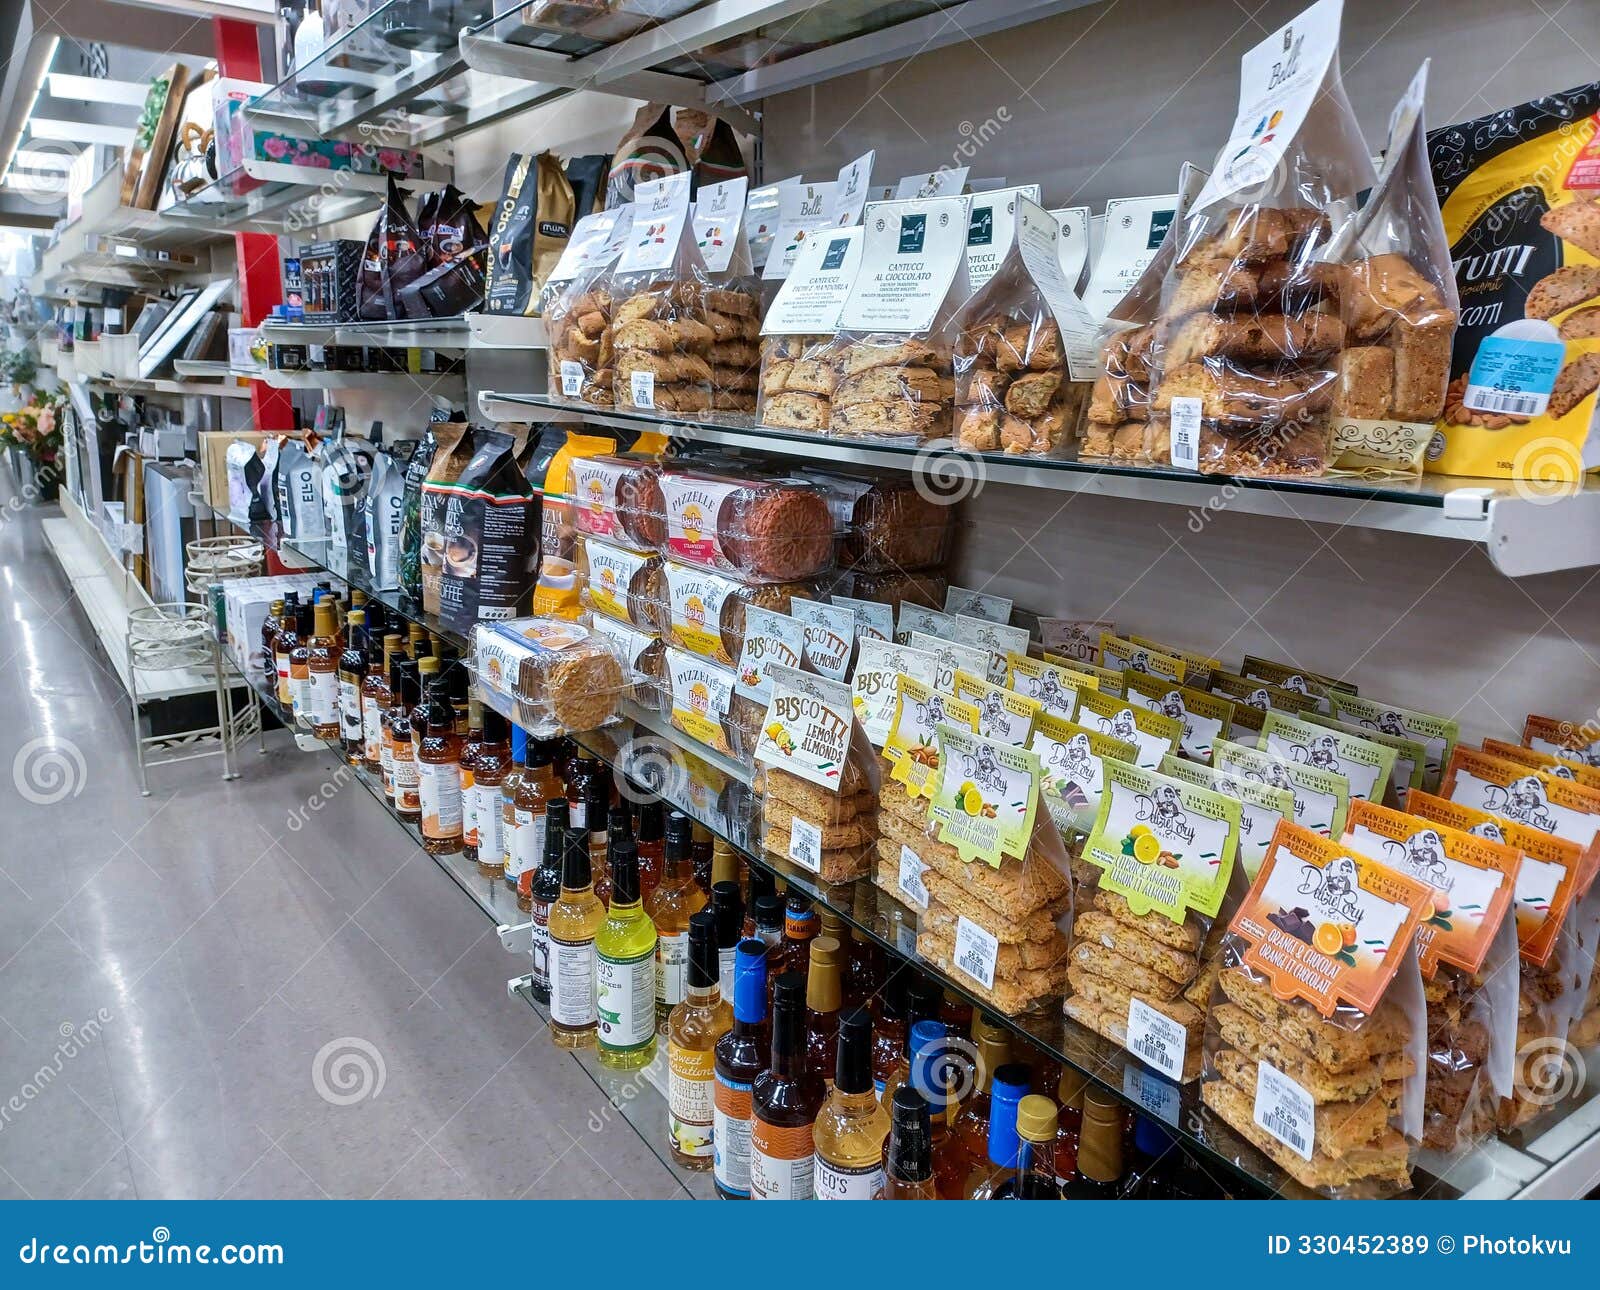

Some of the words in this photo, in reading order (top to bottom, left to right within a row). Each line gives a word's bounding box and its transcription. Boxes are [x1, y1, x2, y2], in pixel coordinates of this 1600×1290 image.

[885, 271, 932, 281] CIOCCOLATO
[888, 263, 925, 272] CANTUCCI
[672, 490, 717, 512] PIZZELLE
[592, 555, 616, 572] PIZZE
[440, 584, 463, 602] OFFEE
[675, 582, 702, 600] PIZZE
[746, 636, 799, 668] BISCOTTI
[804, 627, 849, 659] SCOTTI
[810, 651, 842, 671] ALMOND
[1339, 699, 1376, 715] HANDMADE
[775, 696, 849, 741] BISCOTTI
[1408, 718, 1443, 731] BISCUITS
[806, 723, 837, 743] LEMON
[1274, 721, 1311, 737] HANDMADE
[801, 737, 844, 764] ALMONDS
[1346, 743, 1380, 758] BISCUITS
[1360, 753, 1379, 764] MAIN
[1113, 769, 1151, 785] HANDMADE
[1173, 765, 1209, 781] HANDMADE
[1297, 771, 1332, 786] BISCUITS
[1116, 776, 1148, 792] BISCUITS
[1313, 781, 1333, 793] MAIN
[1188, 794, 1225, 811] BISCUITS
[1205, 806, 1226, 819] MAIN
[1361, 811, 1409, 831] HANDMADE
[1287, 832, 1329, 857] HANDMADE
[1454, 841, 1501, 860] BISCUITS
[1516, 834, 1564, 855] BISCUITS
[1471, 854, 1501, 868] MAIN
[1536, 848, 1563, 861] MAIN
[1368, 871, 1410, 895] BISCUITS
[1268, 929, 1295, 952] ORANGE
[1303, 946, 1342, 980] CHOCOLAT
[1258, 943, 1289, 969] ORANGE
[1293, 961, 1333, 996] CHOCOLATE
[1144, 1033, 1167, 1051] $5.99
[1274, 1106, 1298, 1128] $5.99
